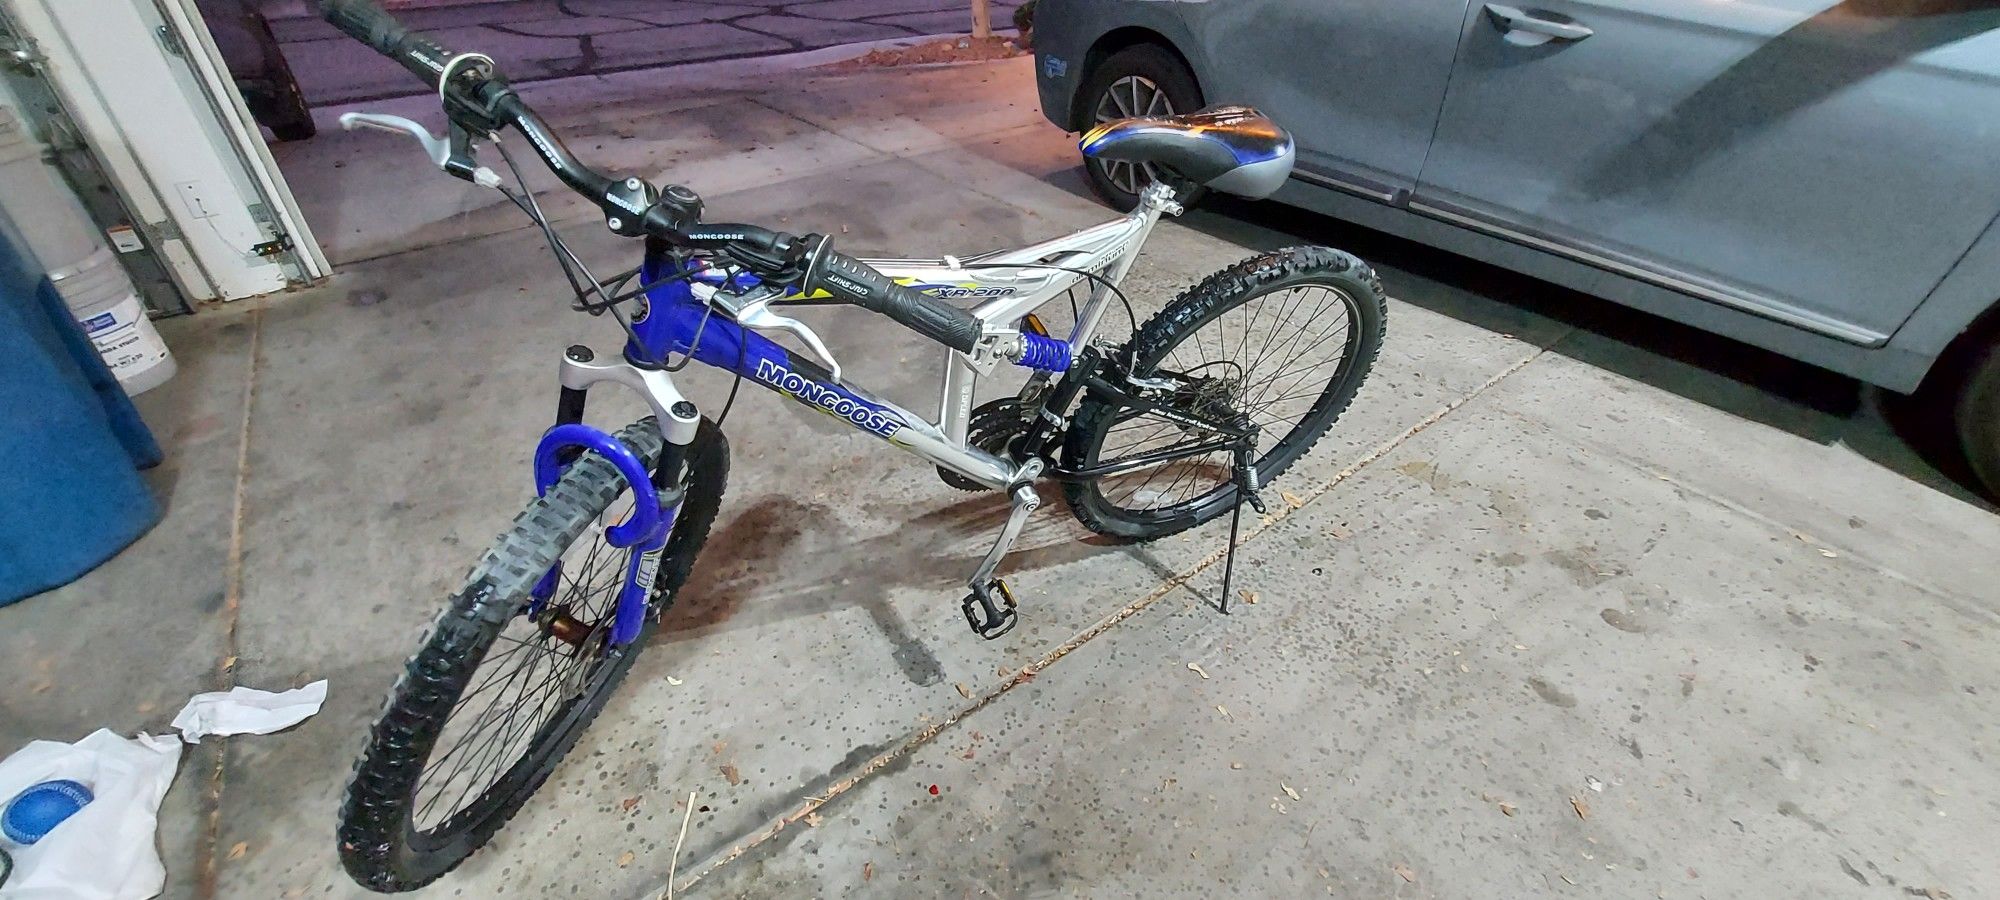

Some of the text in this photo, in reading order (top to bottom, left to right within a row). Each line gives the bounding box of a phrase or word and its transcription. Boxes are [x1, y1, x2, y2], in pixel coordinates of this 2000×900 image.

[517, 115, 562, 170] MONGOOSE
[606, 192, 641, 216] MONGOOSE
[938, 286, 1018, 300] XR-200
[755, 357, 902, 439] MONGOOSE
